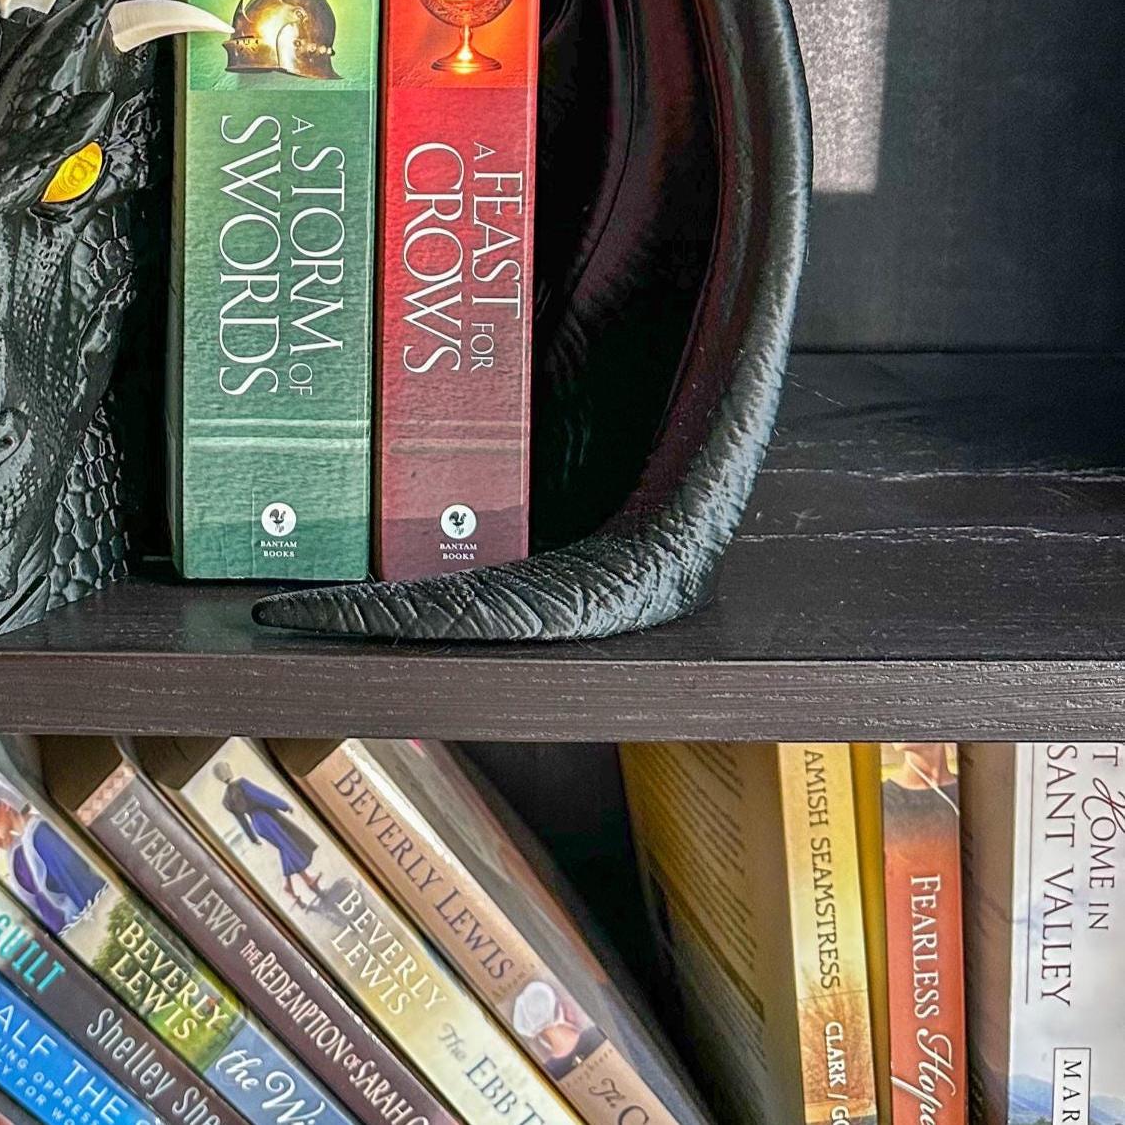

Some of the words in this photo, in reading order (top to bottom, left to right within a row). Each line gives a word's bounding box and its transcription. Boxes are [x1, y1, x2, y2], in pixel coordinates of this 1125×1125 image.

[291, 114, 314, 135] A
[473, 141, 497, 160] A
[218, 114, 282, 396] SWORDS
[289, 145, 346, 353] STORM
[402, 142, 466, 374] CROWS
[471, 171, 523, 320] FEAST
[289, 362, 313, 396] OF
[470, 321, 495, 372] FOR
[261, 540, 298, 548] BANTAM
[263, 550, 295, 558] BOOKS
[443, 552, 475, 560] BOOKS
[804, 750, 829, 828] AMISH
[1045, 744, 1078, 848] SANT
[331, 769, 445, 891] BEVERLY
[435, 887, 516, 980] LEWIS
[811, 837, 841, 989] SEAMSTRESS
[1088, 902, 1109, 931] IN
[110, 795, 195, 888] BEVERLY
[181, 874, 248, 946] LEWIS
[240, 939, 262, 966] THE
[254, 952, 354, 1064] REDEMPTION
[350, 1061, 414, 1125] SARAH
[117, 920, 230, 1030] BEVERLY
[331, 926, 411, 1016] LEWIS
[336, 888, 447, 1011] BEVERLY
[910, 874, 942, 1019] FEARLESS
[1041, 866, 1075, 1007] VALLEY
[109, 955, 198, 1040] LEWIS
[15, 1078, 47, 1106] FOR
[63, 1058, 129, 1124] THE
[86, 1007, 177, 1099] Shelley
[215, 1049, 263, 1090] the
[436, 1023, 467, 1062] The
[462, 1055, 519, 1116] EBB
[825, 1021, 847, 1089] CLARK
[1062, 1059, 1082, 1123] MAR
